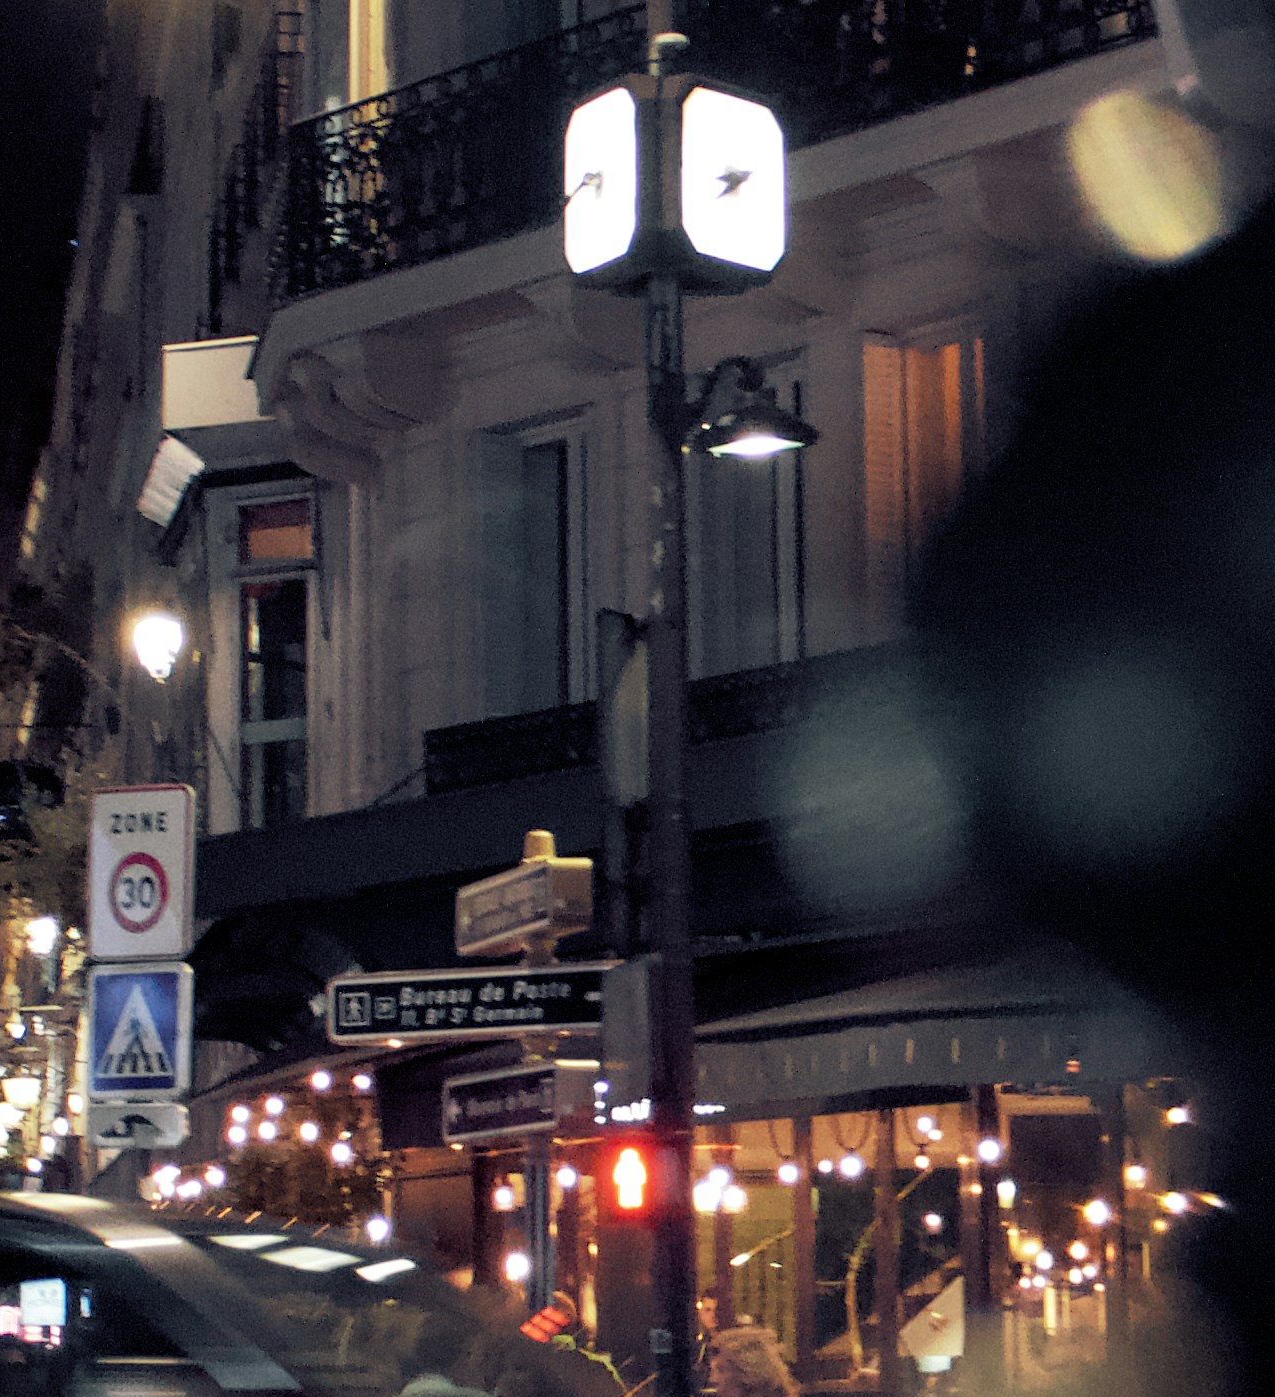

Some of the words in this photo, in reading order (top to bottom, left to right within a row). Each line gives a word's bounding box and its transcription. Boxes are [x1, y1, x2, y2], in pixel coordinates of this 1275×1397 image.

[110, 810, 167, 834] ZONE
[119, 876, 155, 910] 30
[399, 985, 472, 1006] Bureau
[479, 982, 505, 1002] de
[513, 980, 571, 1000] Poste
